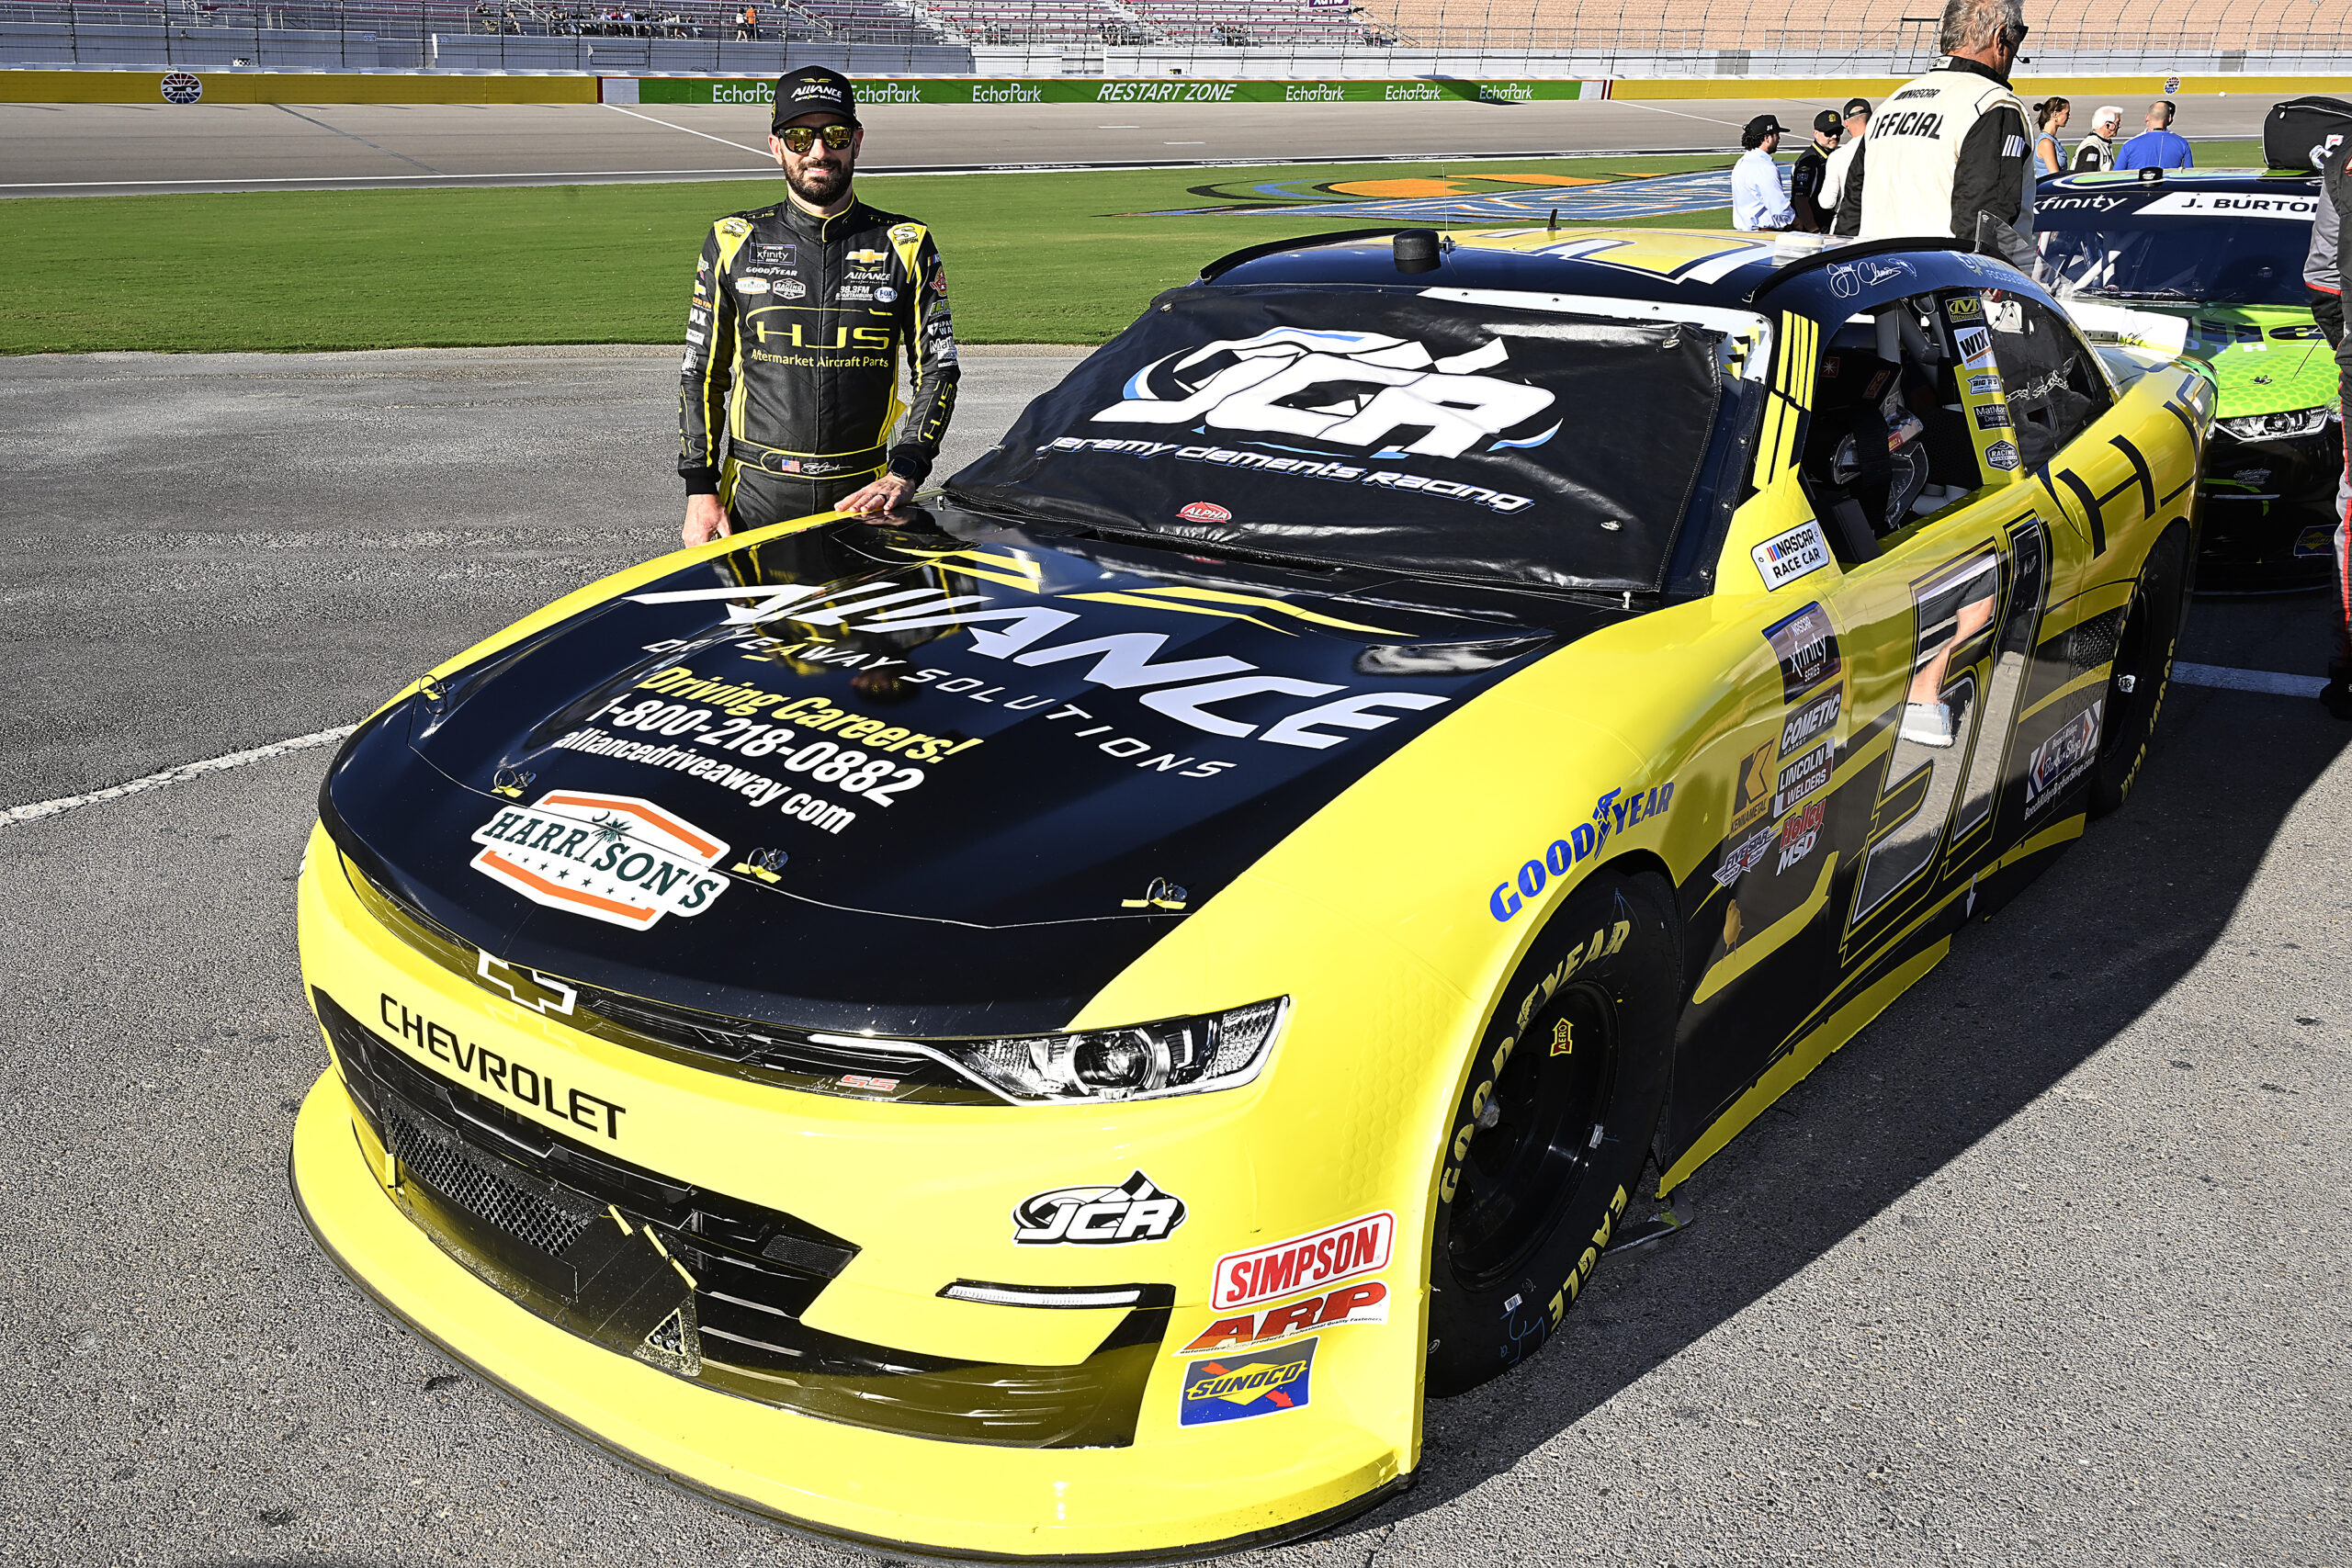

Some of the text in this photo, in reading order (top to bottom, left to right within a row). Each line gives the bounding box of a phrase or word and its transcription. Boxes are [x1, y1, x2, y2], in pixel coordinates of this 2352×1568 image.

[712, 84, 775, 103] EchoPa
[790, 85, 842, 98] ALLIANCE
[972, 84, 1042, 102] EchoPark
[1097, 83, 1237, 102] RESTART ZONE
[1285, 83, 1345, 102] EchoPark
[1385, 83, 1442, 101] EchoPark
[1478, 83, 1533, 101] EchoPark
[2181, 197, 2203, 209] J.
[745, 266, 798, 276] GOODYEAR
[757, 249, 789, 261] xfinity
[844, 271, 891, 281] ALLIANCE
[756, 321, 890, 350] HJS
[1959, 329, 1989, 357] WIX
[751, 348, 889, 368] Aftermarket Aircraft Parts
[1174, 444, 1364, 485] clements
[1991, 449, 2016, 457] RACING
[1183, 506, 1228, 520] ALPHA
[1775, 527, 1816, 558] NASCAR
[1772, 547, 1822, 580] RACE CAR
[1790, 615, 1814, 637] NASCAR
[621, 581, 1452, 751] ALLIANCE
[1788, 633, 1827, 679] xfinity
[1804, 662, 1821, 682] SERIES
[634, 666, 985, 764] Driving Careers!
[641, 628, 1238, 779] DREAWAY SOLUTIONS
[1781, 693, 1841, 750] COMETIC
[584, 692, 925, 809] 1-800-218-0882
[1783, 736, 1808, 756] GASKET
[554, 727, 793, 808] alliancedriveaway
[1779, 747, 1826, 792] LINCOLN
[1786, 768, 1827, 806] WELDERS
[1780, 797, 1827, 849] Holley
[481, 810, 721, 912] HARRISON'S
[1489, 782, 1675, 923] GOODYEAR
[1775, 831, 1817, 877] MSD
[1558, 1024, 1567, 1050] AERO
[379, 992, 628, 1142] CHEVROLET
[1441, 919, 1631, 1204] GOODYEAR
[1226, 1224, 1378, 1303] SIMPSON
[1547, 1183, 1628, 1336] EAGLE
[1183, 1281, 1387, 1351] ARP
[1191, 1360, 1306, 1401] SUNOCO
